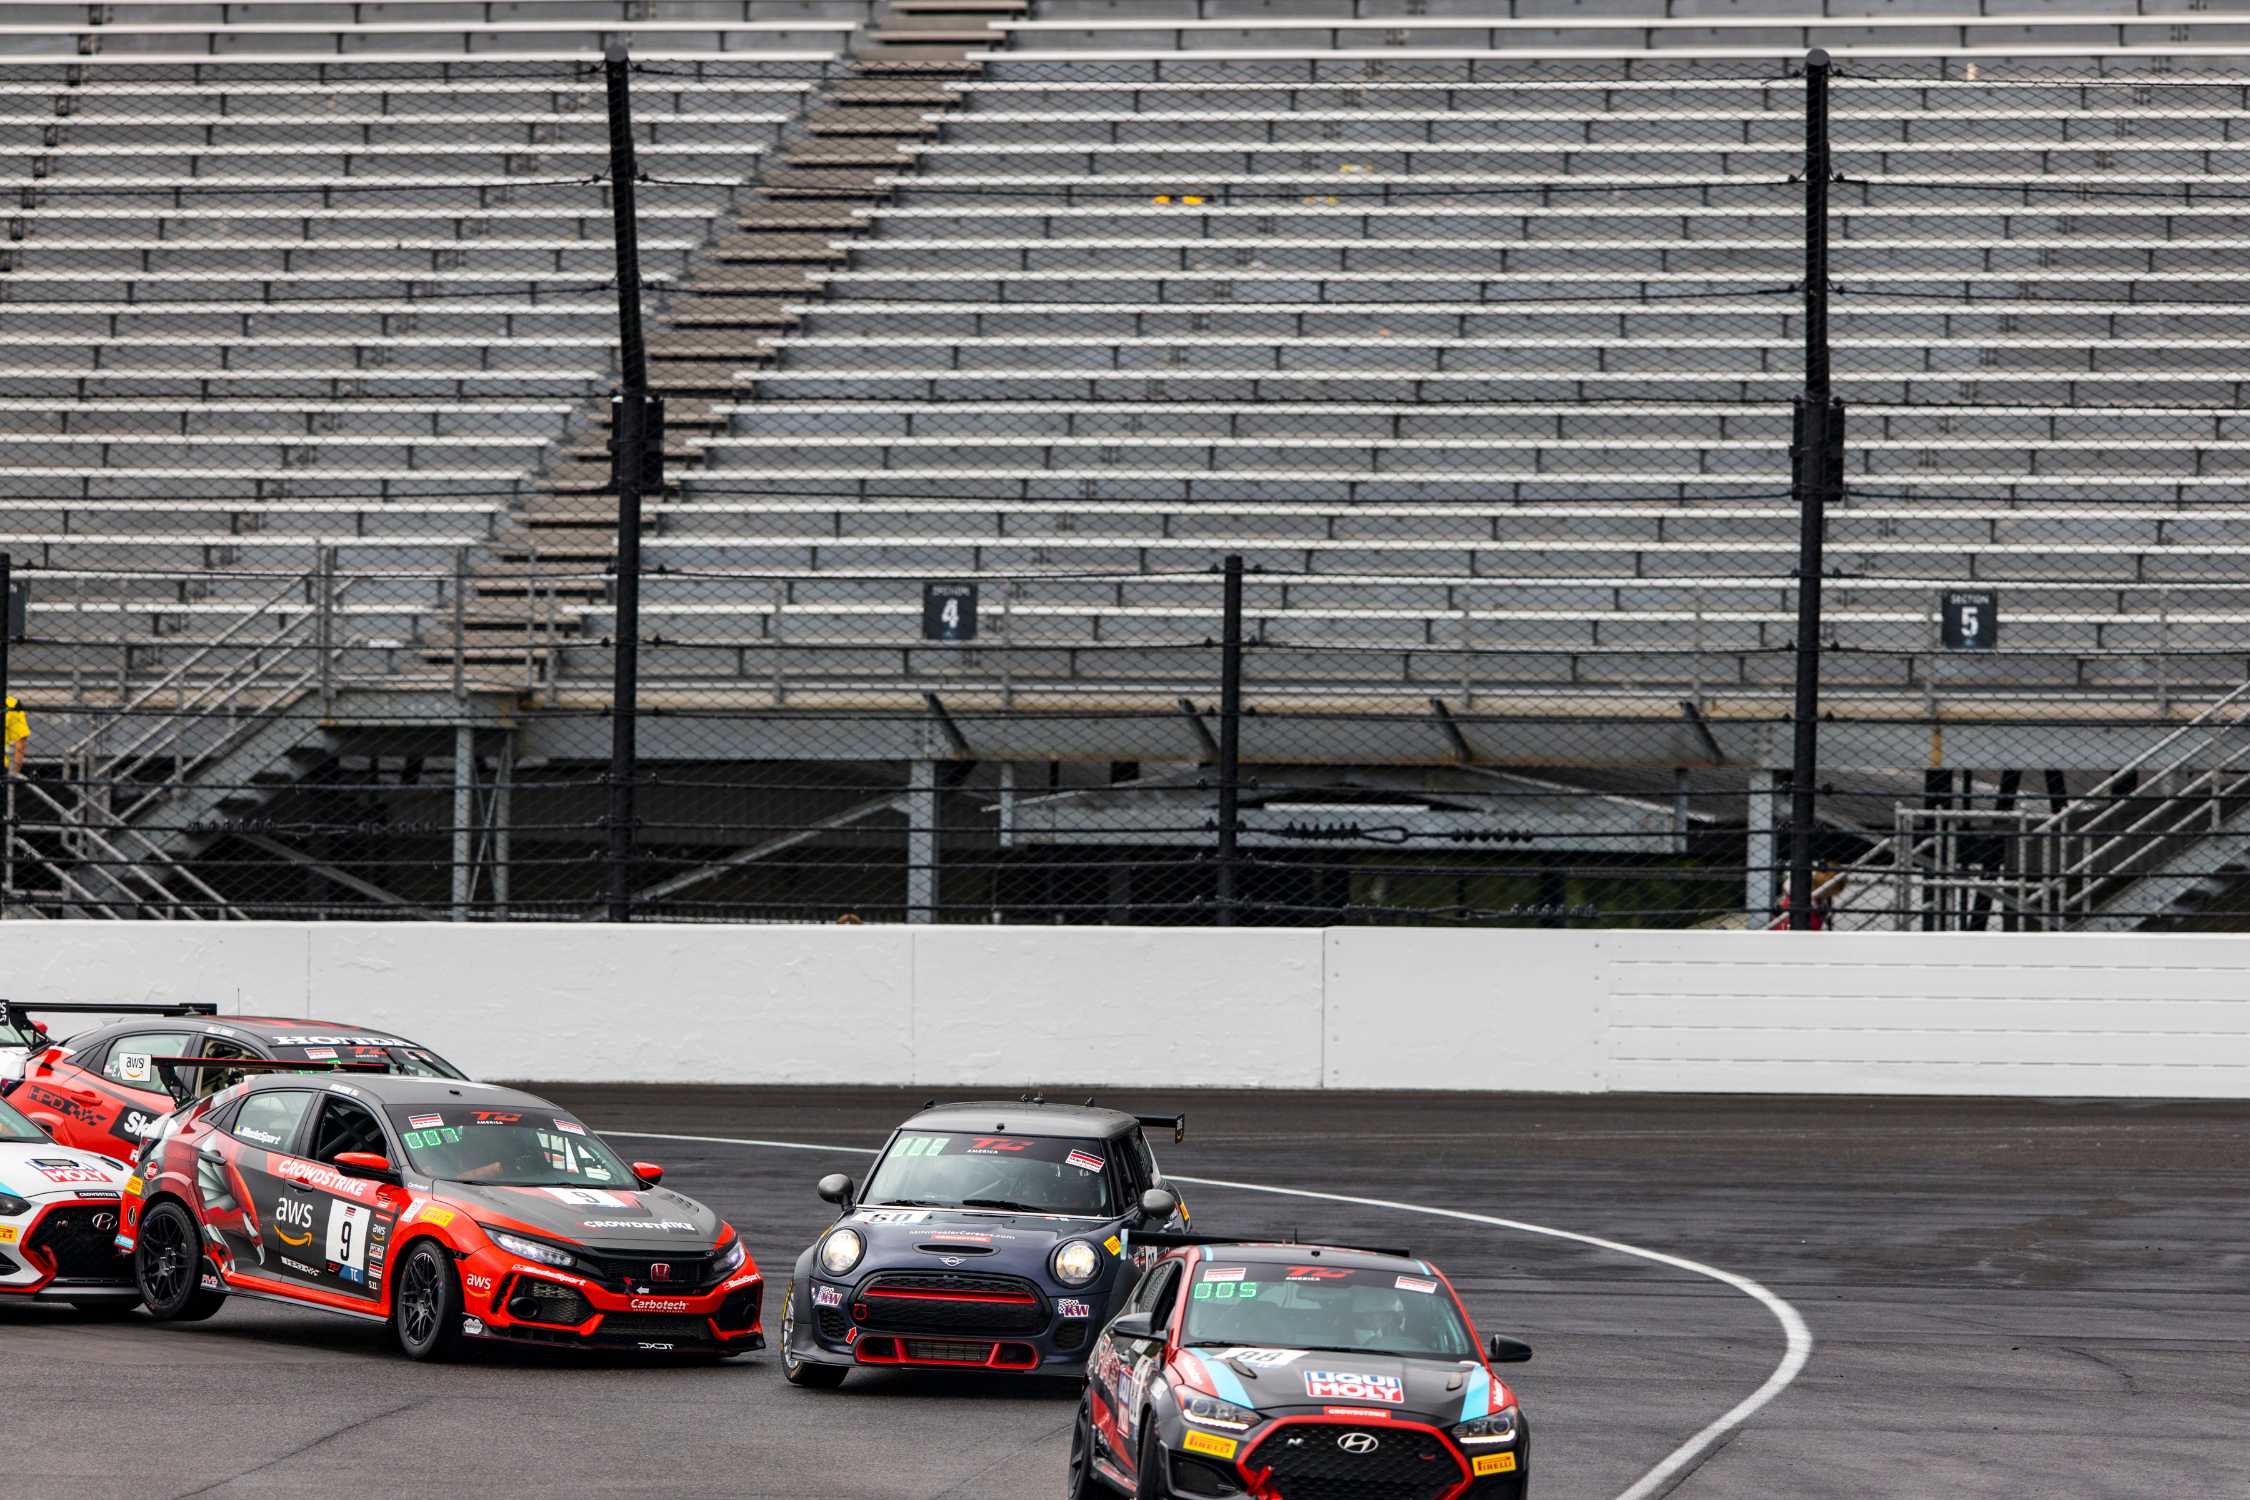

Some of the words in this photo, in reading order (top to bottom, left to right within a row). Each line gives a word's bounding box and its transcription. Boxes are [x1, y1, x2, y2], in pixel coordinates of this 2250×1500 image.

[941, 599, 960, 628] 4
[1961, 606, 1979, 637] 5
[126, 1056, 145, 1069] aws
[968, 1137, 1035, 1151] TC
[46, 1169, 109, 1182] MOLY
[278, 1159, 368, 1197] CROWDSTRIKE
[276, 1197, 314, 1229] aws
[372, 1223, 387, 1235] aws
[583, 1219, 696, 1232] CROWDSTRIKE
[340, 1220, 352, 1262] 9
[466, 1273, 492, 1290] aws
[630, 1299, 688, 1311] Carbotech
[1065, 1304, 1089, 1317] KW
[1307, 1370, 1402, 1388] LIQUI
[1311, 1382, 1401, 1401] MOLY
[1477, 1457, 1513, 1473] PIRELLI
